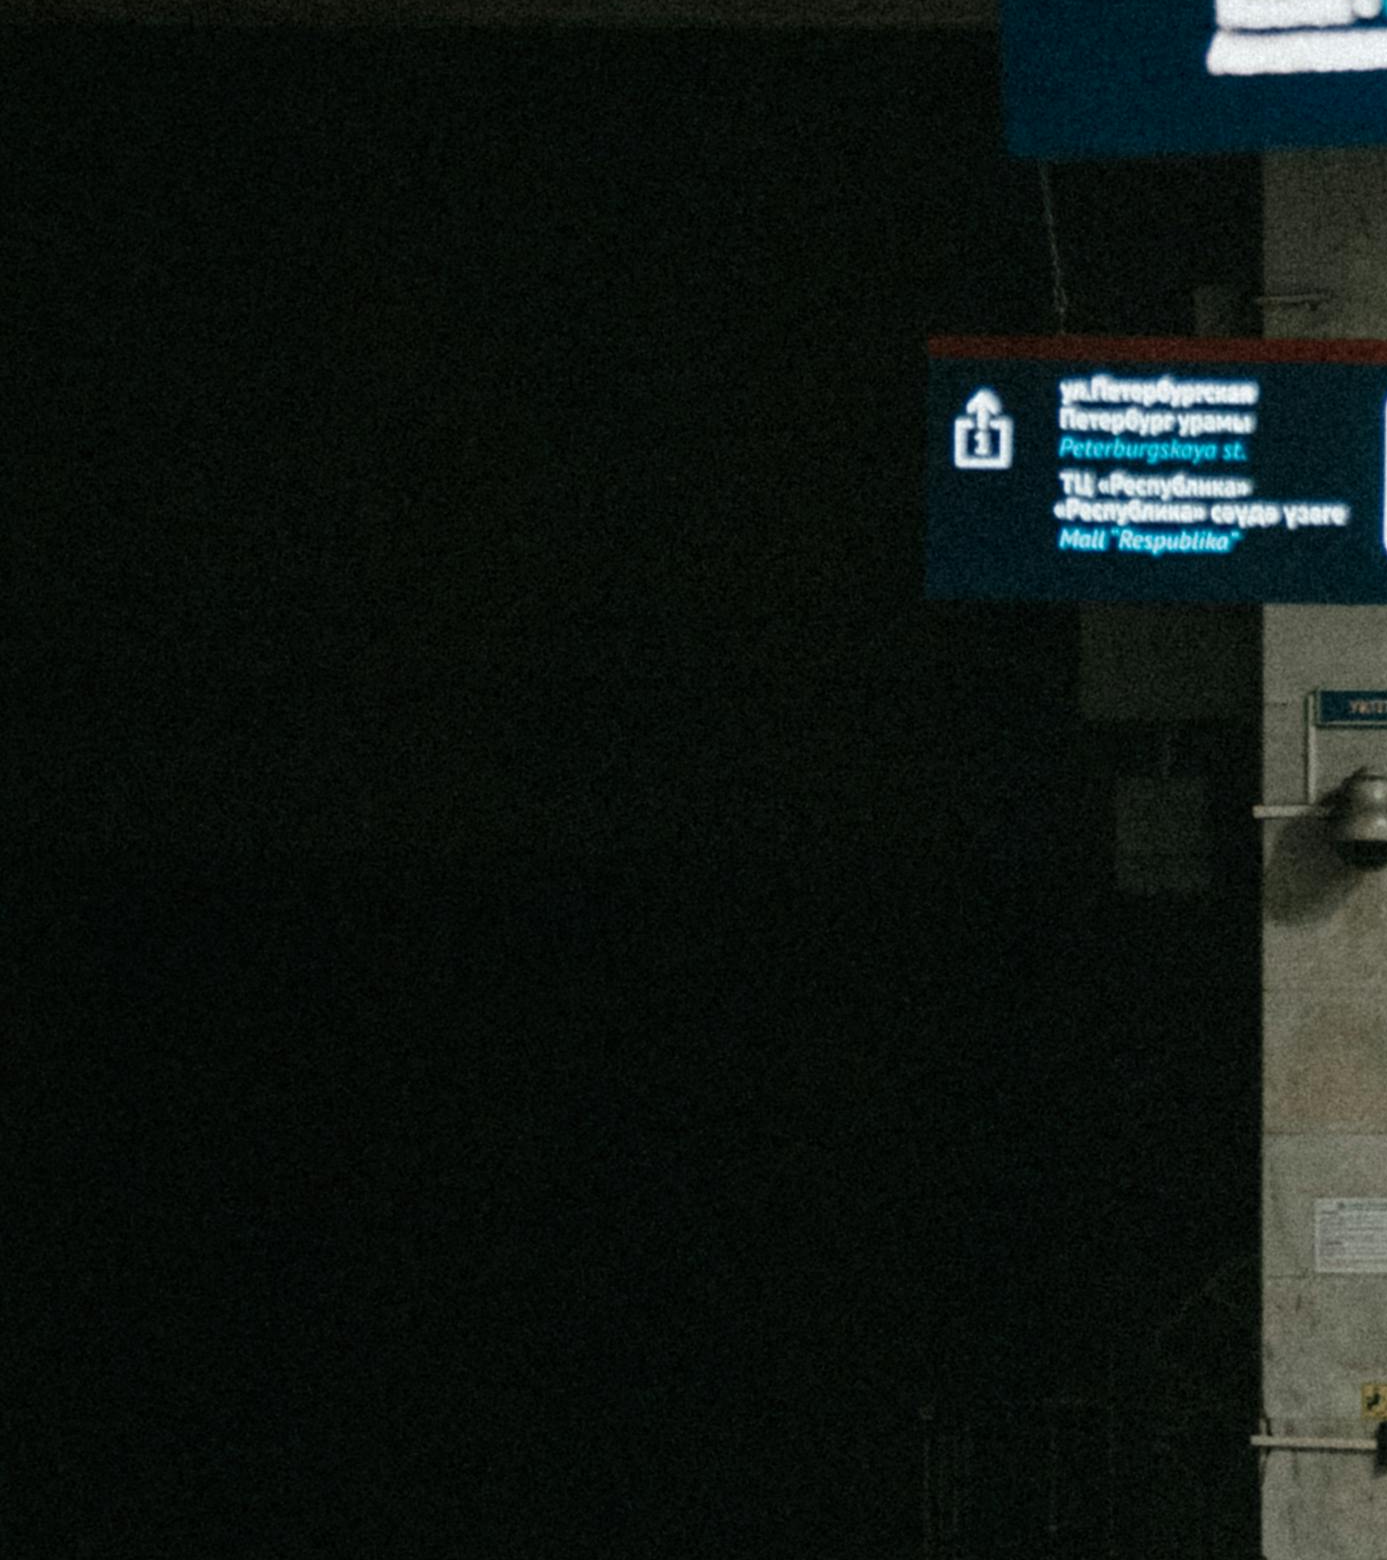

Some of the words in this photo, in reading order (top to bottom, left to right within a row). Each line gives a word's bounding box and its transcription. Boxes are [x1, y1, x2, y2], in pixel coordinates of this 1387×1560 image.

[1059, 406, 1176, 437] Петербург
[1059, 437, 1217, 464] Peterburgskaya
[1222, 442, 1248, 461] st.
[1059, 471, 1096, 497] ТЦ
[1059, 528, 1108, 551] Mall
